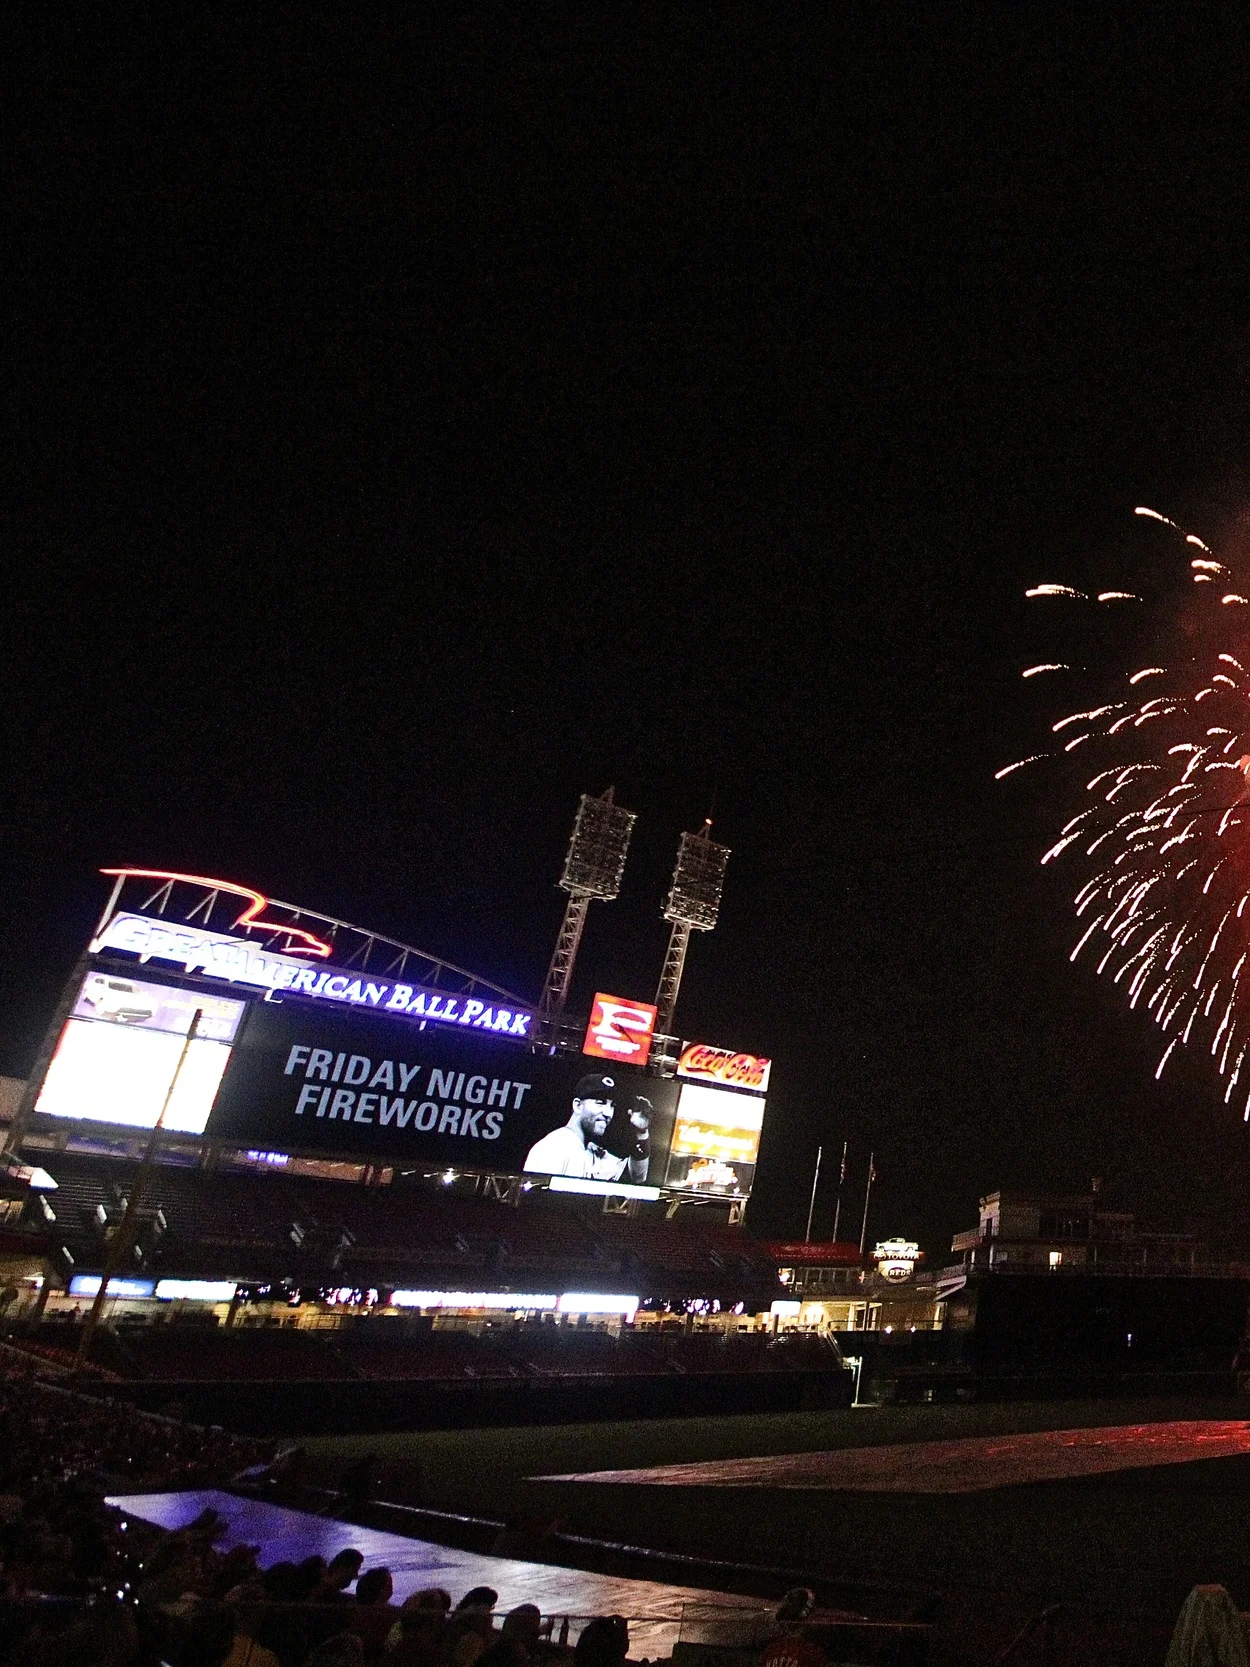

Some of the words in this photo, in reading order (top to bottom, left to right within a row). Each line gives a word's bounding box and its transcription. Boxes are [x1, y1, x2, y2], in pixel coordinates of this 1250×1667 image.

[222, 944, 388, 1004] AMERICAN
[386, 983, 459, 1022] BALL
[459, 998, 531, 1035] PARK
[284, 1045, 421, 1093] FRIDAY
[426, 1068, 531, 1110] NIGHT
[294, 1084, 504, 1140] FIREWORKS
[887, 1251, 920, 1260] TOYOTA
[889, 1268, 912, 1277] REDS
